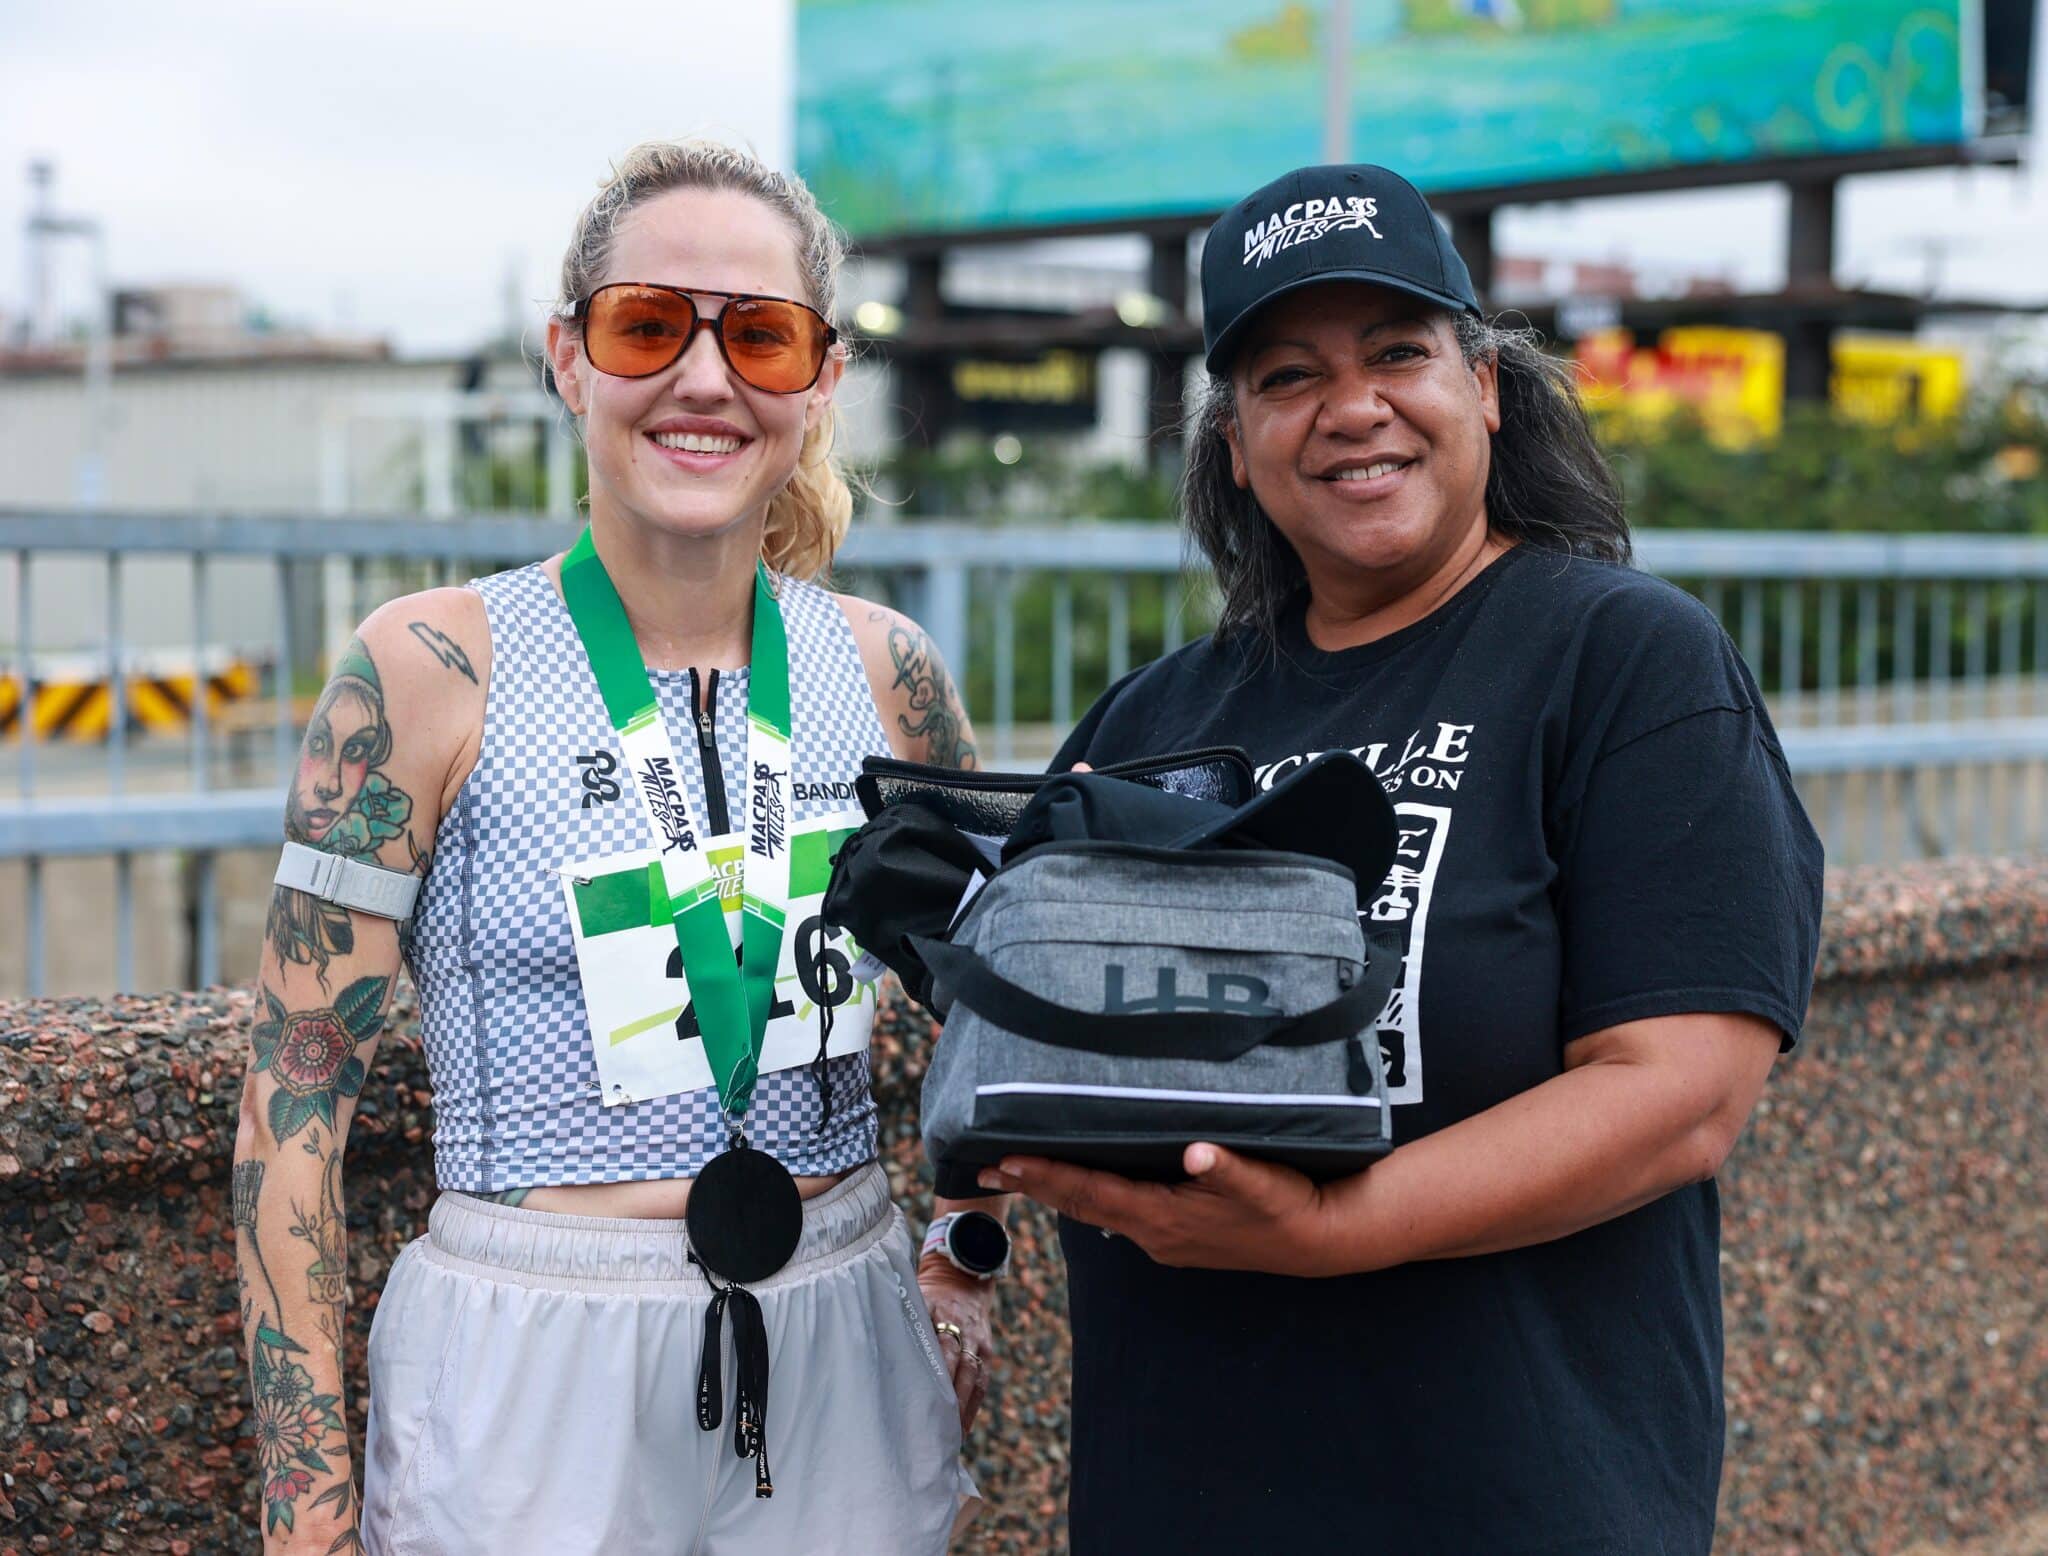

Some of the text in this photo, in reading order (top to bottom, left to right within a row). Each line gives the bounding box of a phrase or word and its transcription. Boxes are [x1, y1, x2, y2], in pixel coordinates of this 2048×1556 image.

[1243, 196, 1378, 256] MACPASS
[1255, 219, 1329, 269] MILES
[637, 770, 671, 823] MILES
[792, 781, 858, 801] BANDI
[1410, 766, 1465, 791] ON
[768, 797, 785, 852] MILES
[913, 1321, 945, 1376] COMMUNITY
